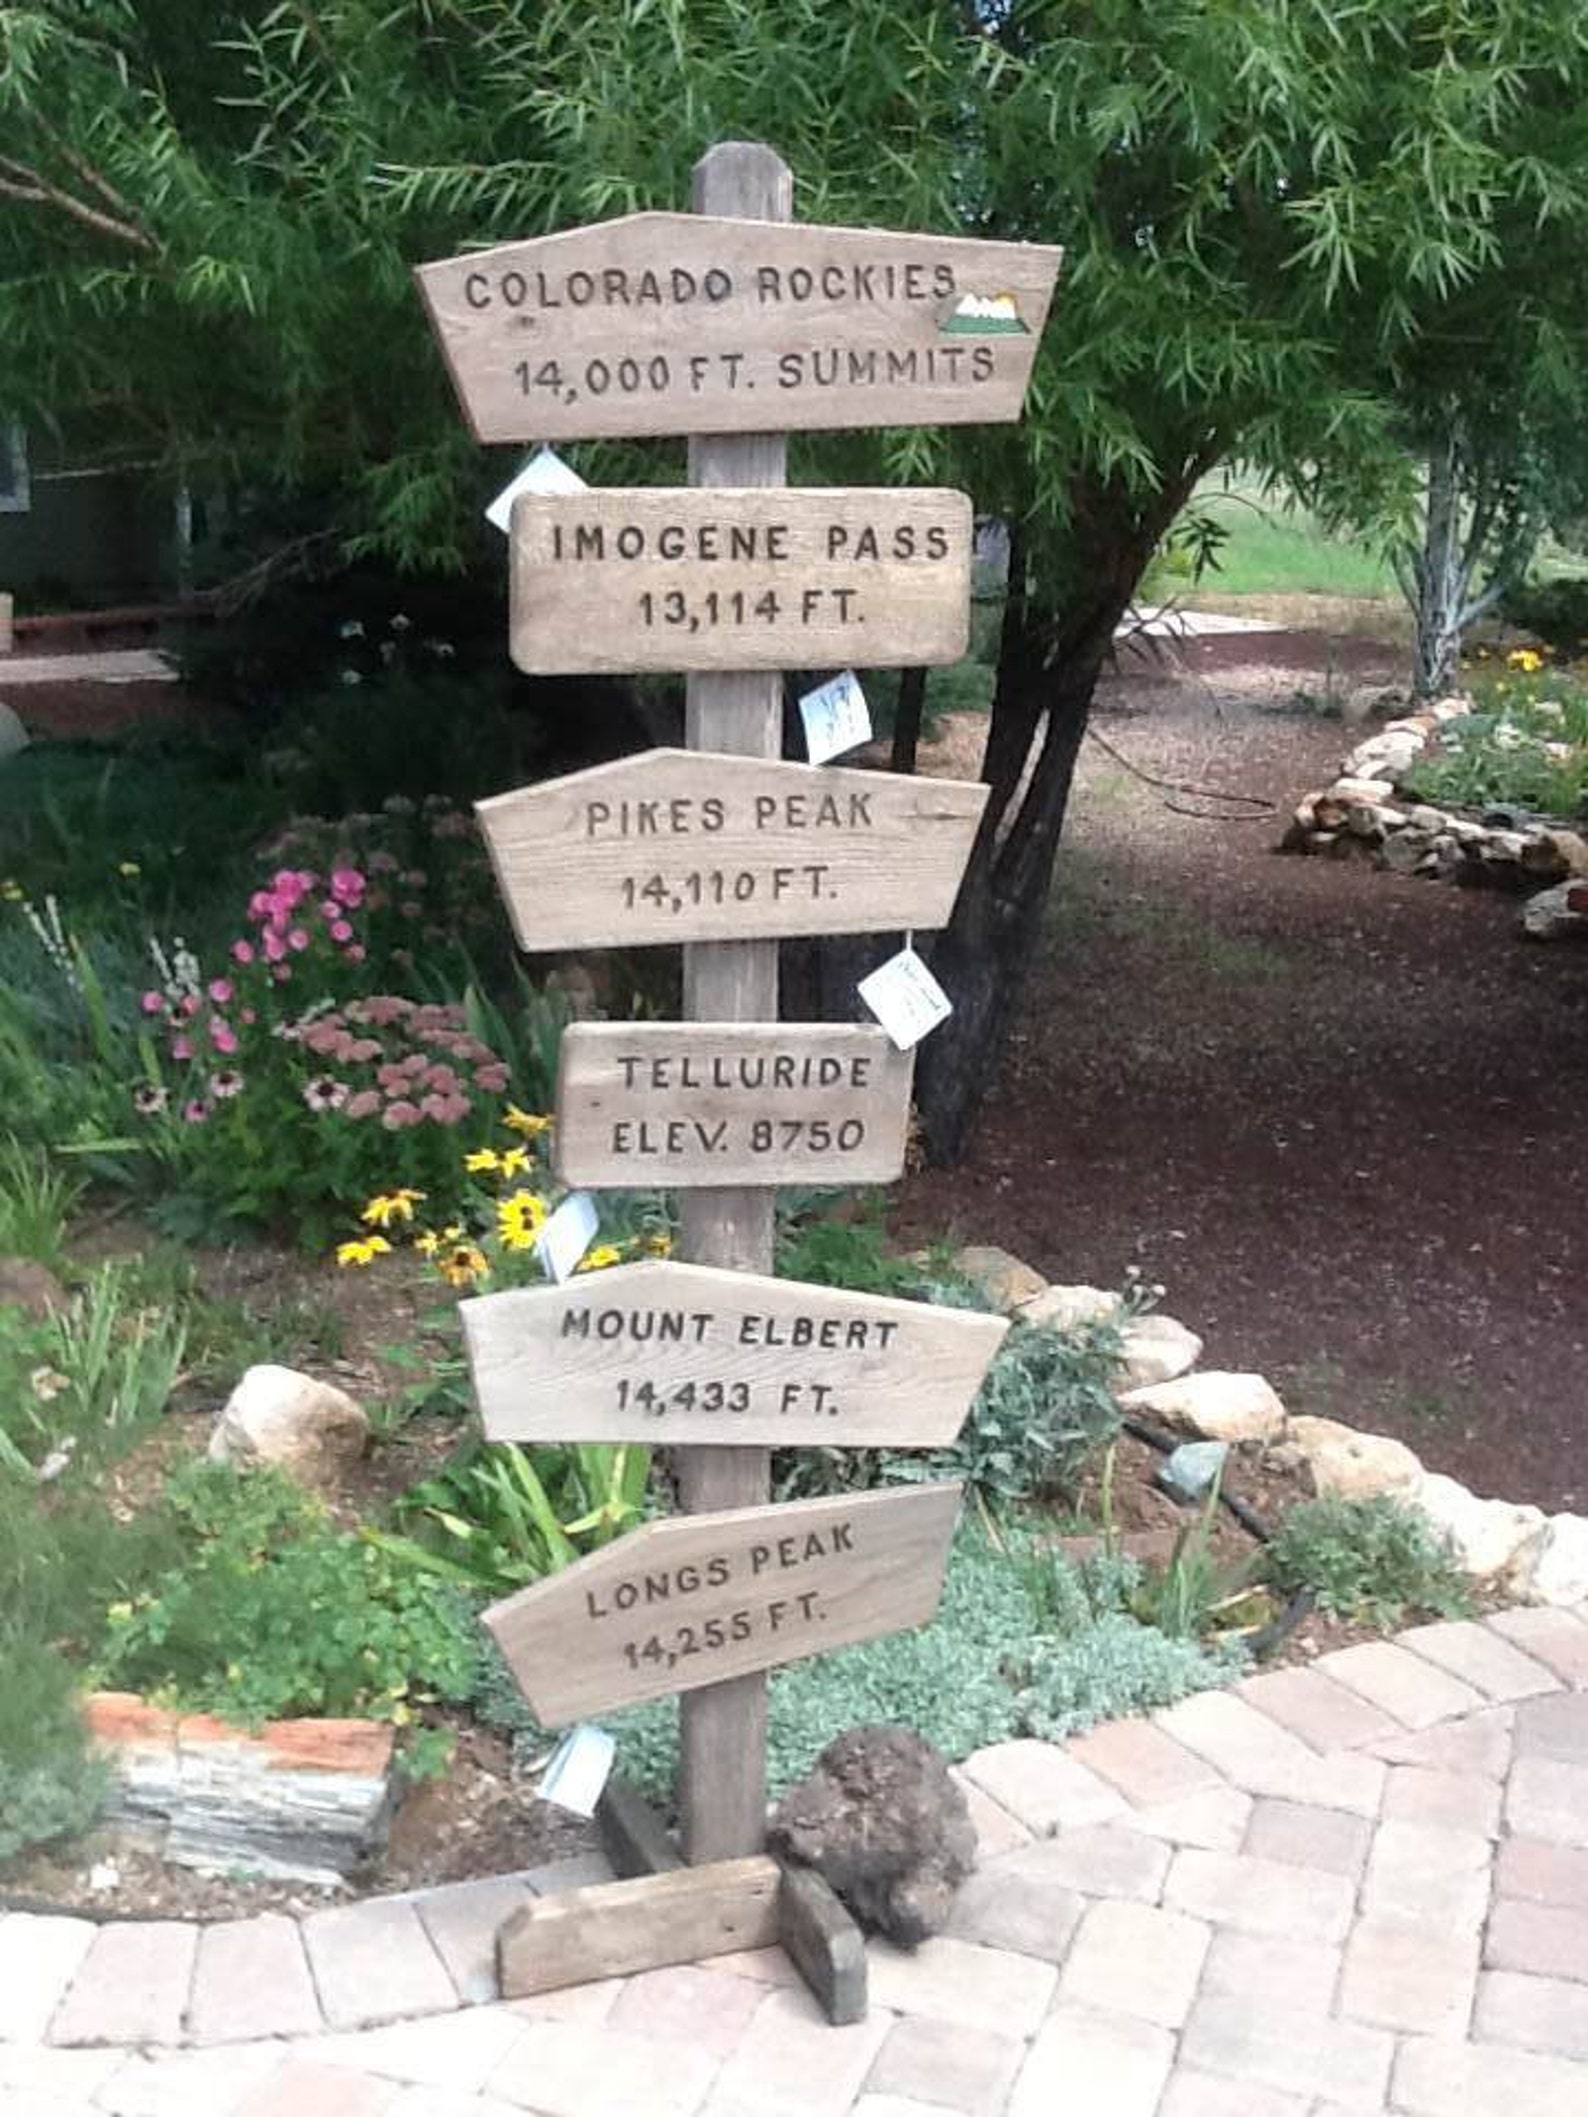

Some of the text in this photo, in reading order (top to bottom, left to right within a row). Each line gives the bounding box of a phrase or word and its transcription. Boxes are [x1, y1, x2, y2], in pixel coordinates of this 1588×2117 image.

[465, 264, 956, 310] COLORADO ROCKIES
[515, 347, 994, 405] 14,000 FT. SUMMITS
[553, 525, 949, 561] IMOGENE PASS
[638, 589, 865, 633] 13,114 FT.
[587, 793, 872, 836] PIKES PEAK
[621, 866, 838, 913] 14,110 FT.
[617, 1056, 871, 1088] TELLURIDE
[612, 1119, 864, 1153] ELEV. 8750
[560, 1308, 898, 1349] MOUNT ELBERT
[616, 1380, 839, 1417] 14,433 FT.
[587, 1523, 854, 1619] LONGS PEAK
[624, 1592, 826, 1670] 14,255 FT.
